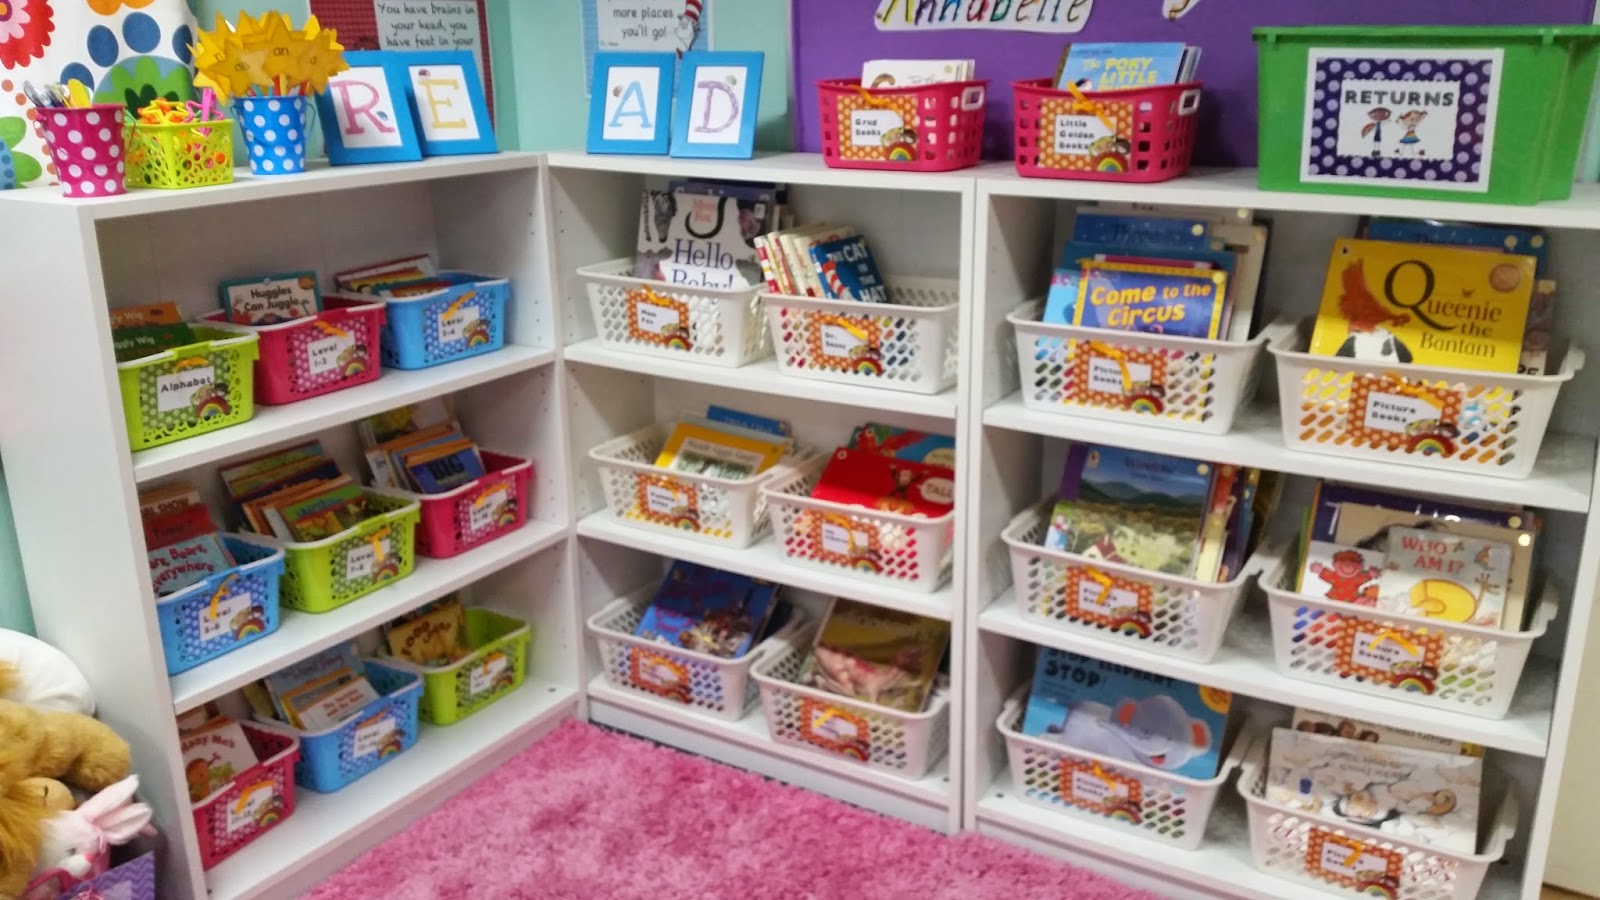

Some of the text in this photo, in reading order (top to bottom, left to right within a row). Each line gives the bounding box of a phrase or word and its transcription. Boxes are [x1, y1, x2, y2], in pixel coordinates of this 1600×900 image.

[378, 1, 475, 14] You have brains in
[613, 8, 673, 24] more places
[391, 22, 414, 36] your
[449, 23, 467, 36] you
[621, 25, 667, 42] you'll go!
[386, 36, 474, 50] have feet in your
[1344, 90, 1454, 107] RETURNS
[1060, 119, 1087, 128] Little
[674, 238, 734, 270] Hello
[843, 242, 869, 262] CAT
[250, 285, 292, 304] Huggles
[858, 285, 888, 303] HAT
[1090, 282, 1212, 307] Come to the
[1384, 259, 1503, 332] Queenie
[243, 297, 299, 313] Can Juggle
[1106, 301, 1187, 327] Circus
[1460, 323, 1494, 338] the
[312, 343, 338, 357] Level
[1419, 331, 1497, 359] Bantam
[160, 375, 213, 393] Alphabet
[1373, 400, 1417, 414] Picture
[1413, 554, 1444, 571] AM
